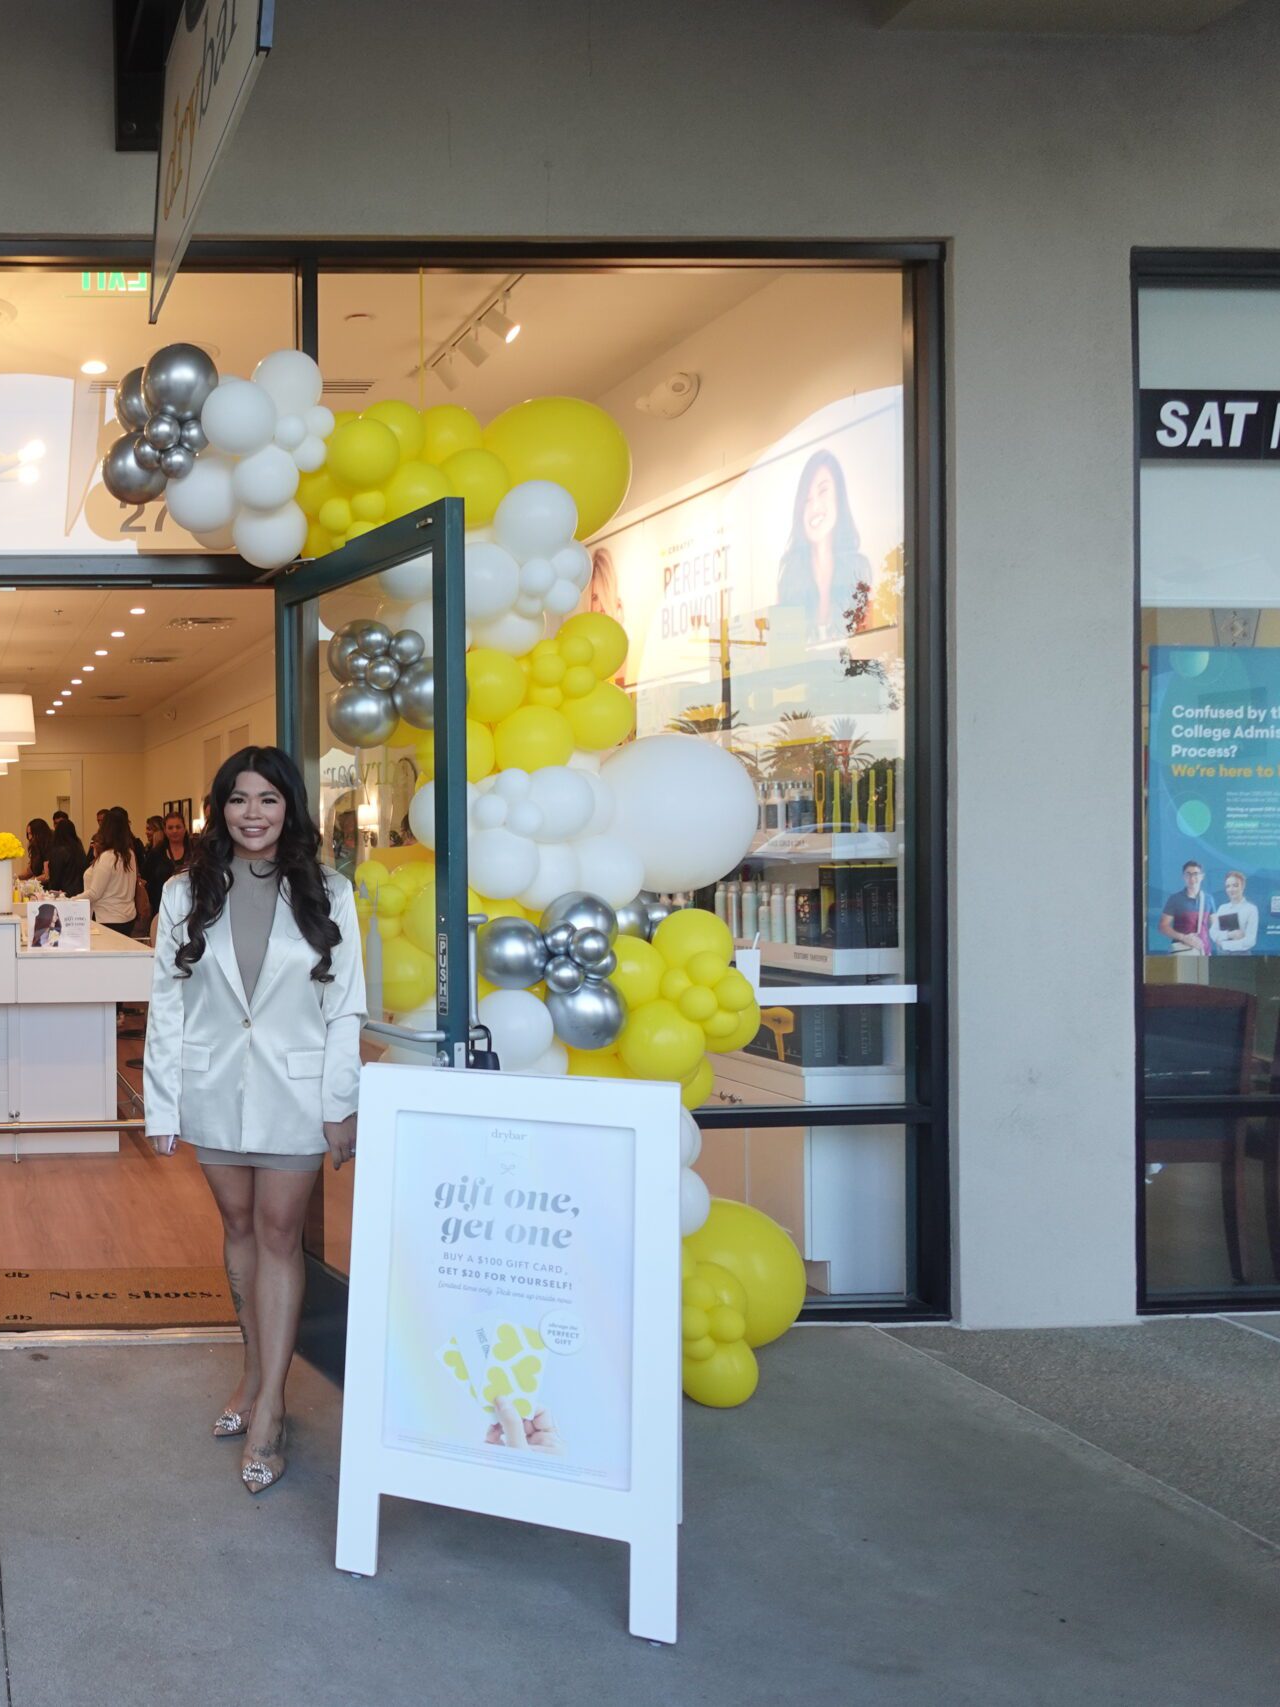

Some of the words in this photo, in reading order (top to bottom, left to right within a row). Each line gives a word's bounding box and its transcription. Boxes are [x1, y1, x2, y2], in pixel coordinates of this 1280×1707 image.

[1156, 400, 1259, 448] SAT
[664, 544, 731, 600] PERFECT
[661, 587, 734, 640] BLOWOUT
[1172, 705, 1244, 719] Confused
[1247, 706, 1267, 722] by
[1171, 725, 1231, 741] College
[1171, 744, 1238, 758] Process?
[1172, 764, 1216, 778] We're
[1219, 764, 1252, 778] here
[1256, 764, 1274, 778] to
[439, 940, 447, 996] PUSH
[491, 1128, 527, 1142] drybar
[434, 1175, 495, 1212] gift
[504, 1188, 580, 1219] one,
[440, 1215, 496, 1245] get
[505, 1223, 573, 1249] one
[443, 1251, 463, 1261] BUY
[467, 1255, 474, 1263] A
[478, 1255, 503, 1266] $100
[506, 1259, 530, 1270] GIFT
[438, 1266, 458, 1276] GET
[461, 1268, 481, 1278] $20
[484, 1271, 506, 1282] FOR
[510, 1275, 573, 1291] YOURSELF!
[49, 1290, 118, 1301] Nice
[128, 1289, 222, 1300] shoes.
[547, 1329, 580, 1339] PERFECT
[554, 1338, 572, 1346] GIFT
